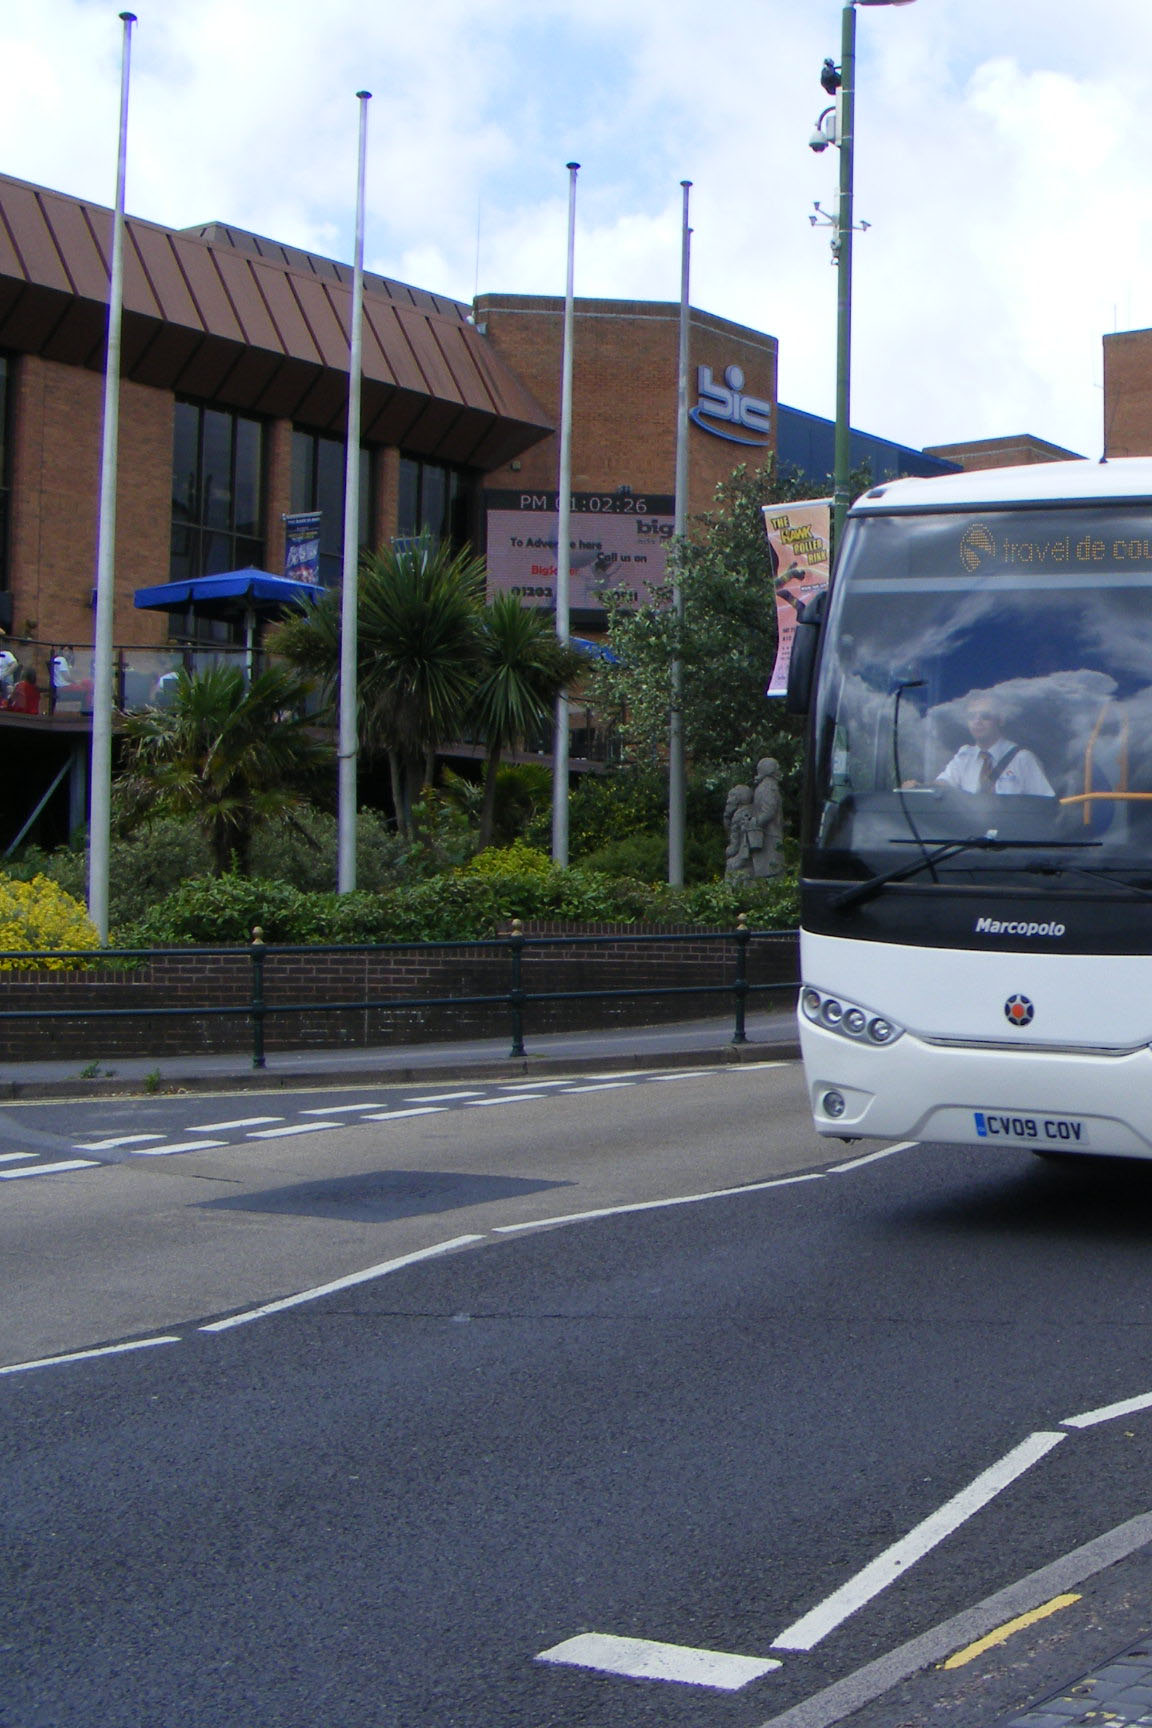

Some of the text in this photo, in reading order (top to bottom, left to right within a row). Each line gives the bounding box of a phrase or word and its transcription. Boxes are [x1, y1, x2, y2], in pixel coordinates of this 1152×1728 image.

[520, 495, 547, 510] PM
[636, 518, 674, 540] big
[771, 516, 790, 531] THE
[510, 537, 523, 547] To
[579, 539, 602, 550] here
[793, 539, 824, 555] ROLLER
[1003, 537, 1070, 563] travel
[1076, 535, 1106, 561] de
[598, 552, 647, 562] Call us on
[807, 550, 828, 565] RINK
[975, 917, 1066, 937] Marcopolo
[986, 1116, 1038, 1138] CV09
